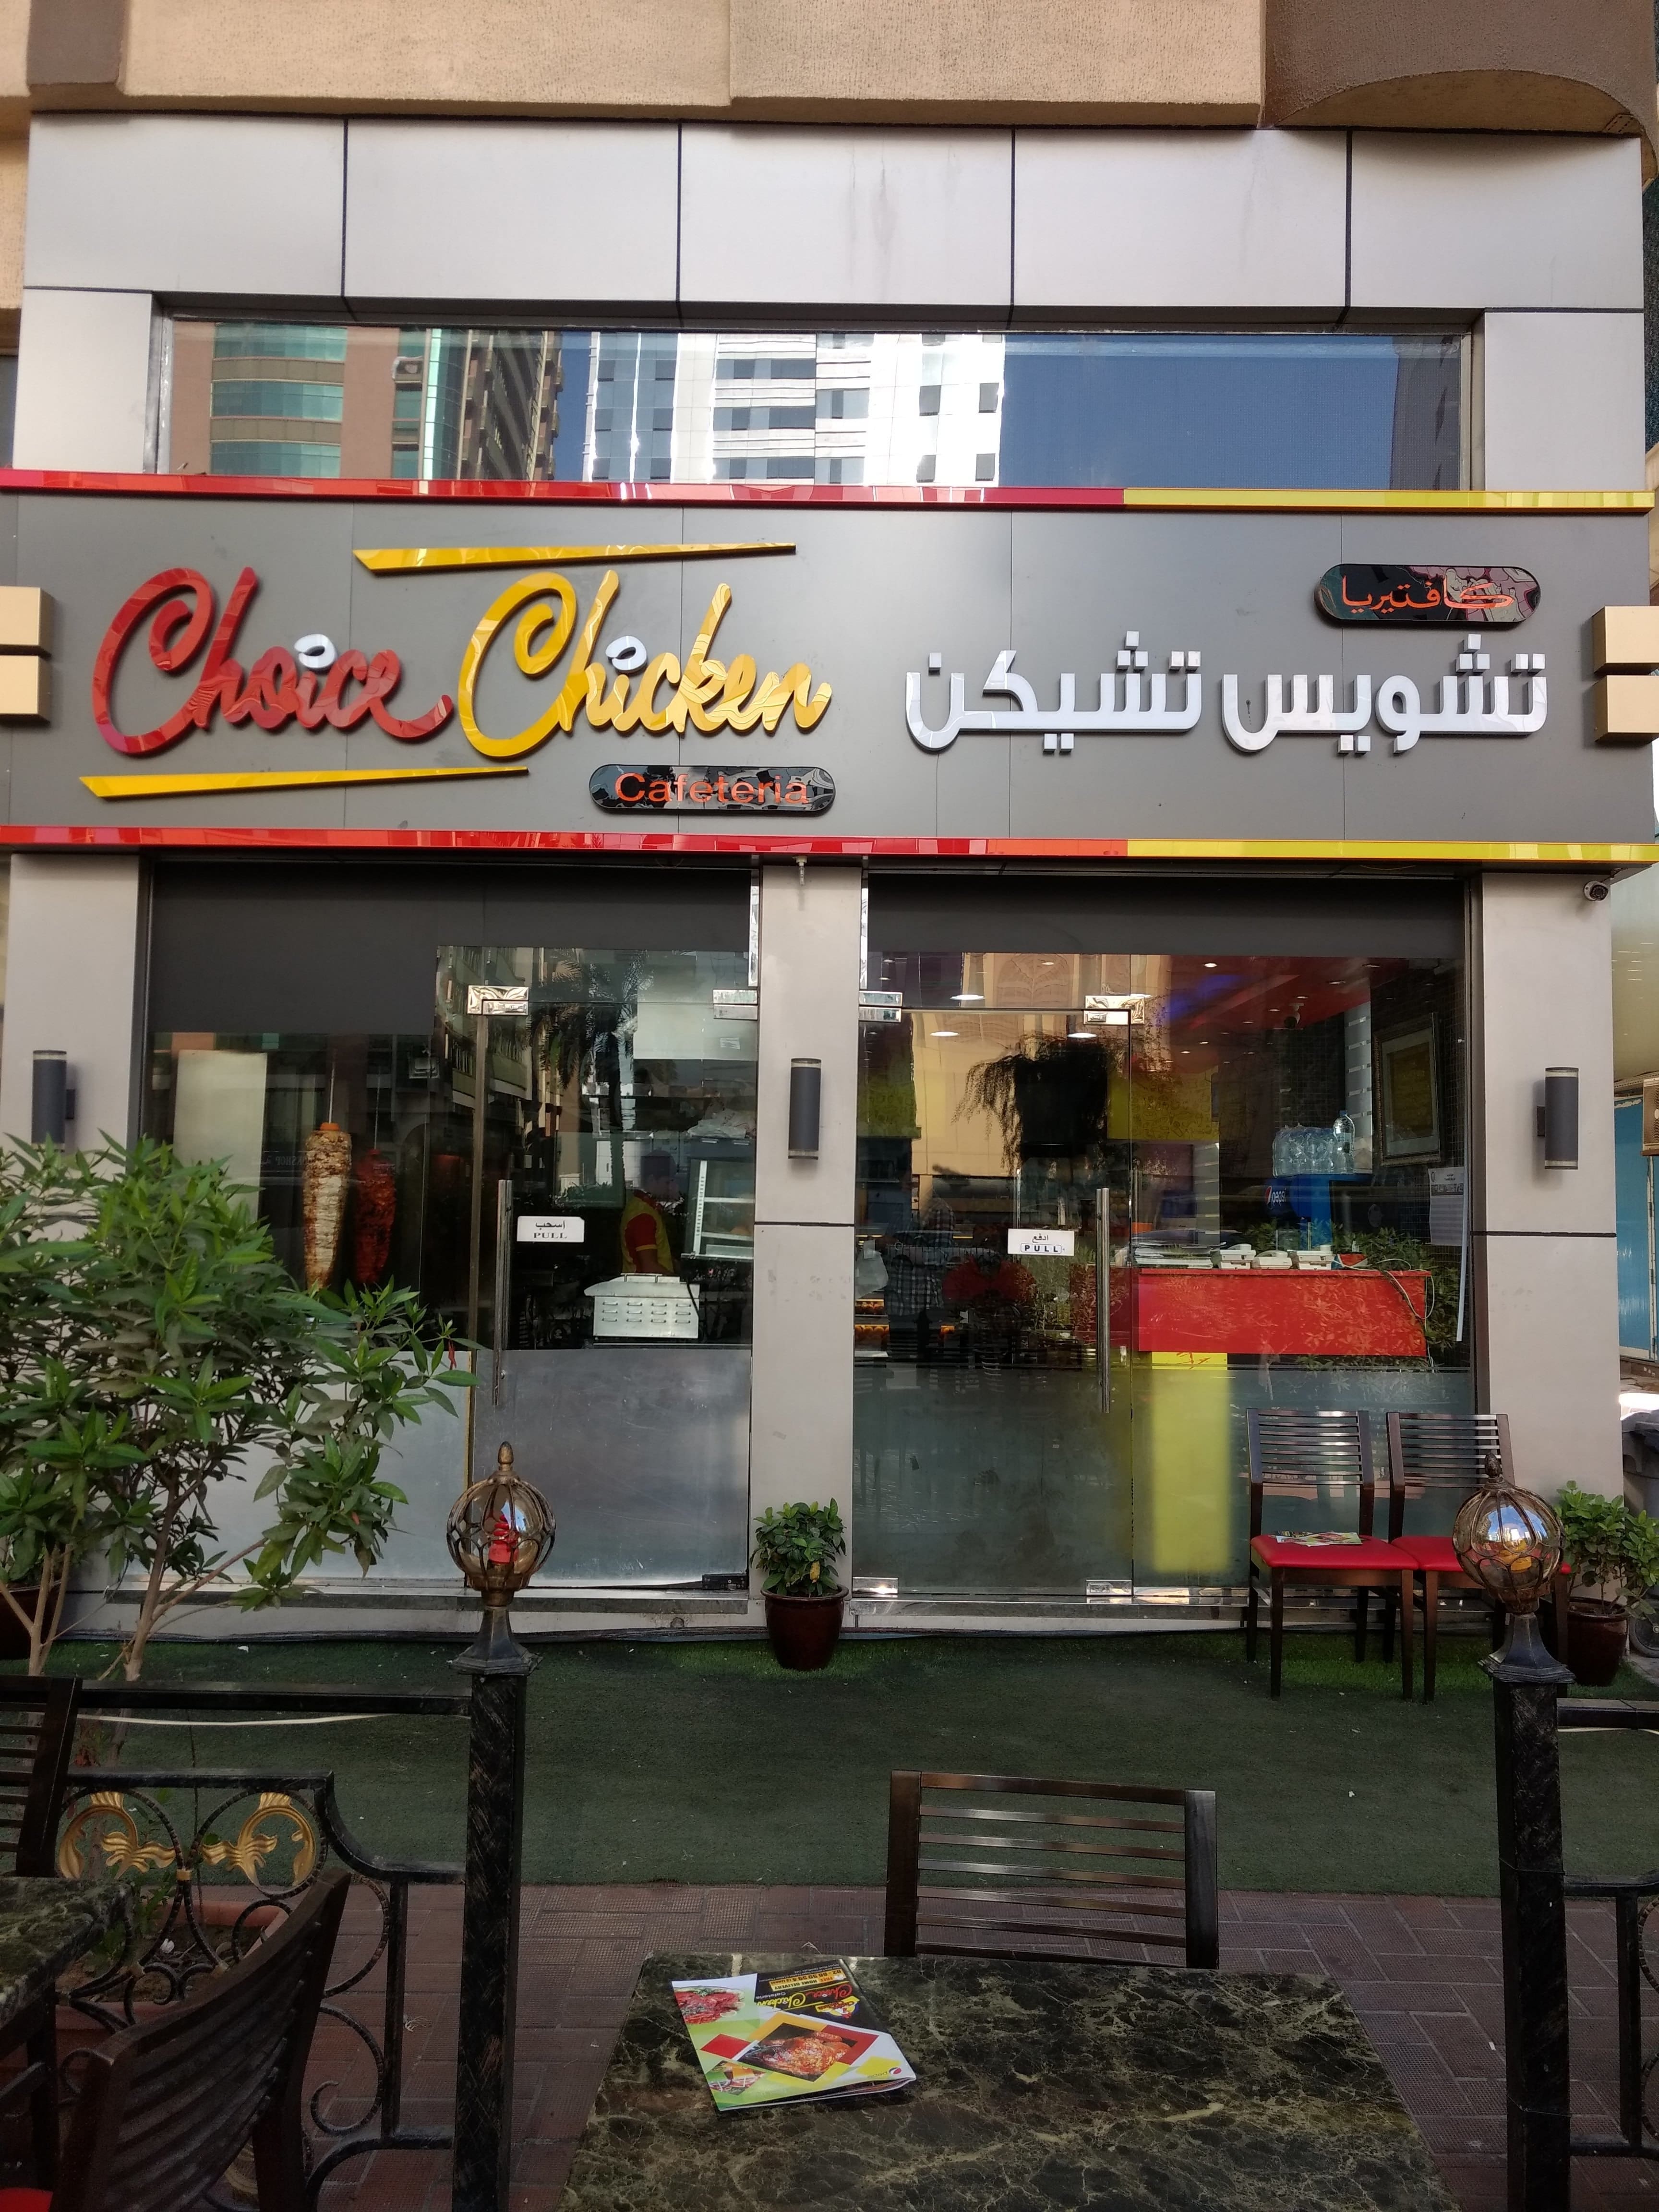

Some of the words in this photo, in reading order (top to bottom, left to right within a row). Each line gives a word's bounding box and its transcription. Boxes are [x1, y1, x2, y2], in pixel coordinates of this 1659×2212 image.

[1342, 575, 1515, 614] كافتيريا
[91, 566, 452, 756] Choice
[458, 569, 832, 759] Chicken
[905, 631, 1201, 753] تشيكن
[1222, 634, 1548, 754] تشويس
[614, 772, 809, 804] Cafeteria
[1272, 1187, 1286, 1206] pepsi
[757, 1992, 806, 2009] Chicken
[805, 1984, 853, 1999] Choice
